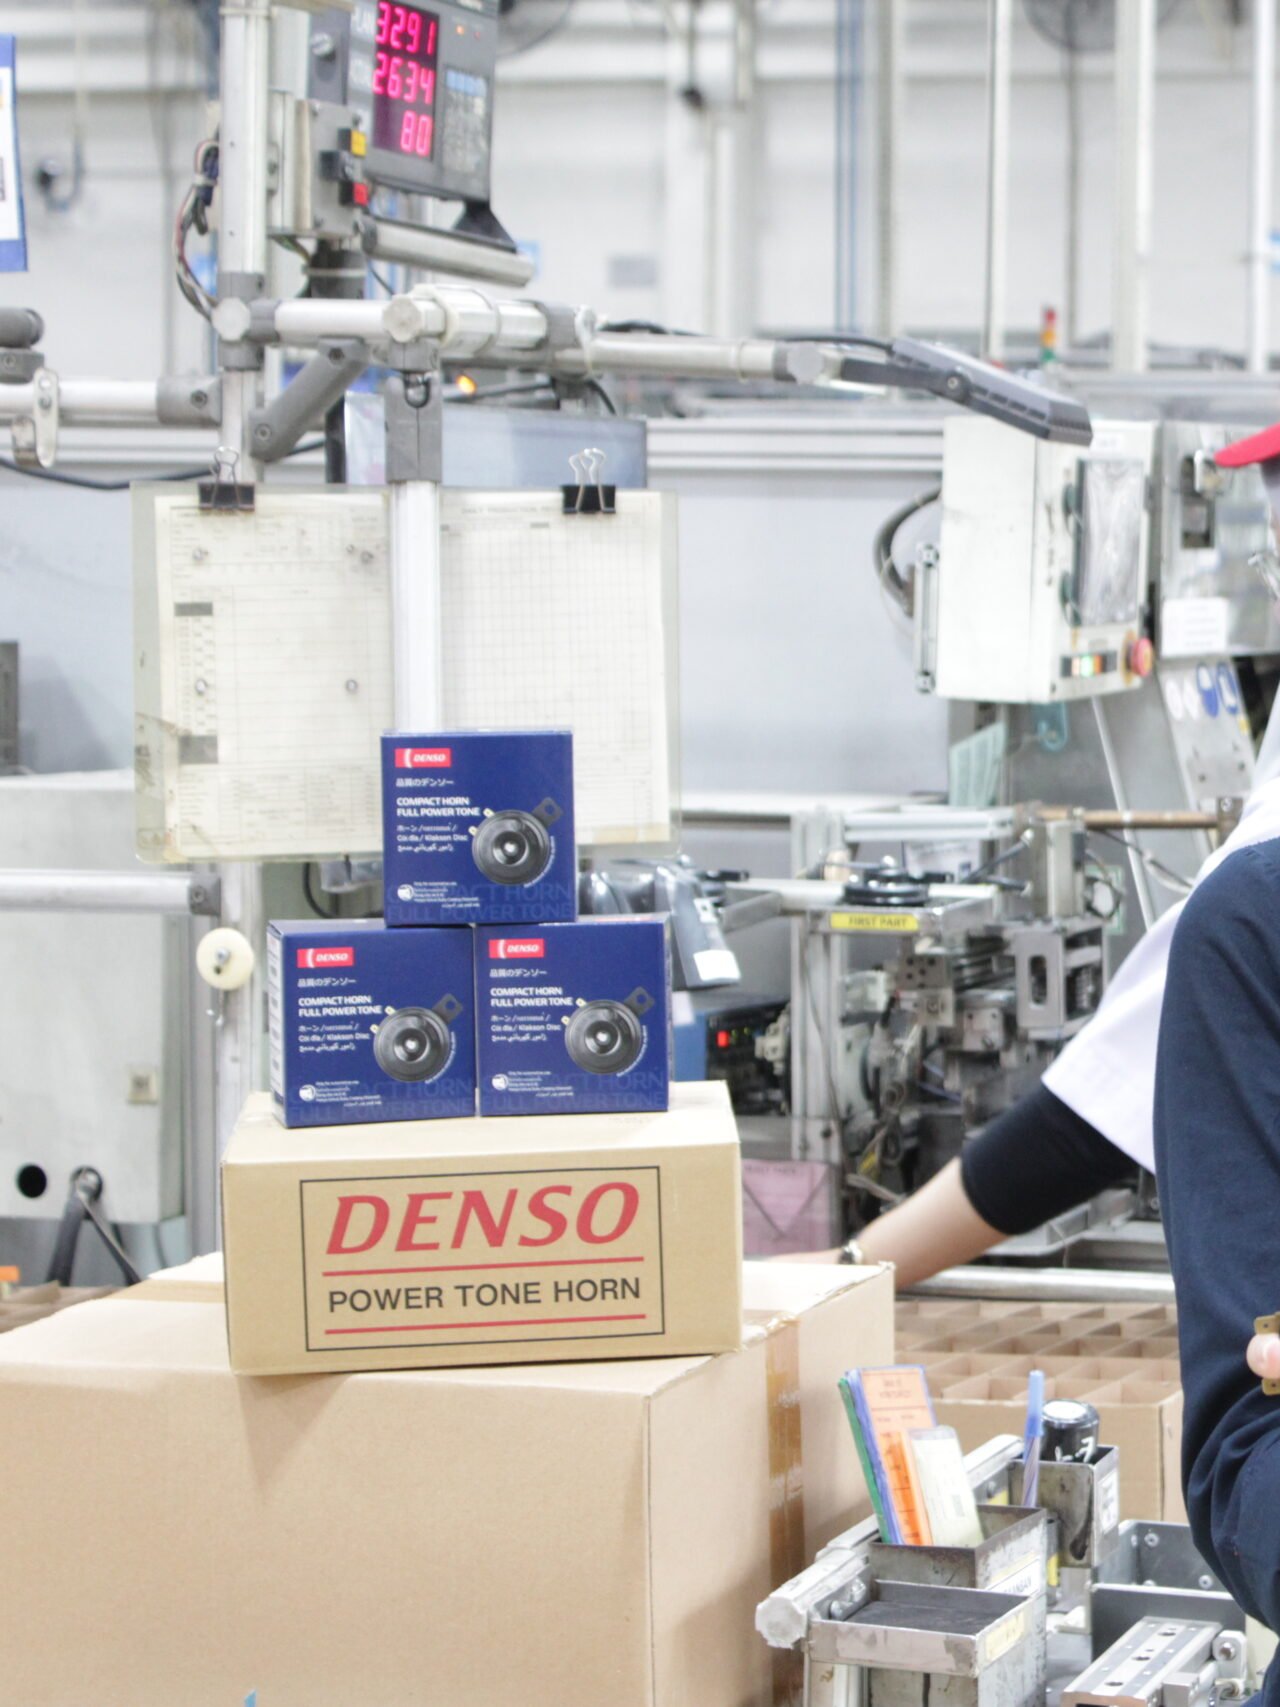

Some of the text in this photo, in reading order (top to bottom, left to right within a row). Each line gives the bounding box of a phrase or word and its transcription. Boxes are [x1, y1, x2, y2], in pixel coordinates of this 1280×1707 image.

[374, 1, 437, 55] 3291
[372, 52, 435, 105] 2634
[401, 110, 433, 157] 80
[413, 754, 446, 762] DENSO
[397, 797, 470, 806] COMPACT HORN
[397, 807, 480, 817] FULL POWER TONE
[849, 915, 906, 927] FIRST PART
[507, 944, 539, 952] DENSO
[316, 953, 348, 962] DENSO
[490, 987, 562, 996] COMPACT HORN
[299, 995, 372, 1006] COMPACT HORN
[490, 997, 573, 1007] FULL POWER TONE
[299, 1005, 382, 1017] FULL POWER TONE
[326, 1181, 640, 1255] DENSO
[329, 1277, 640, 1313] POWER TONE HORN
